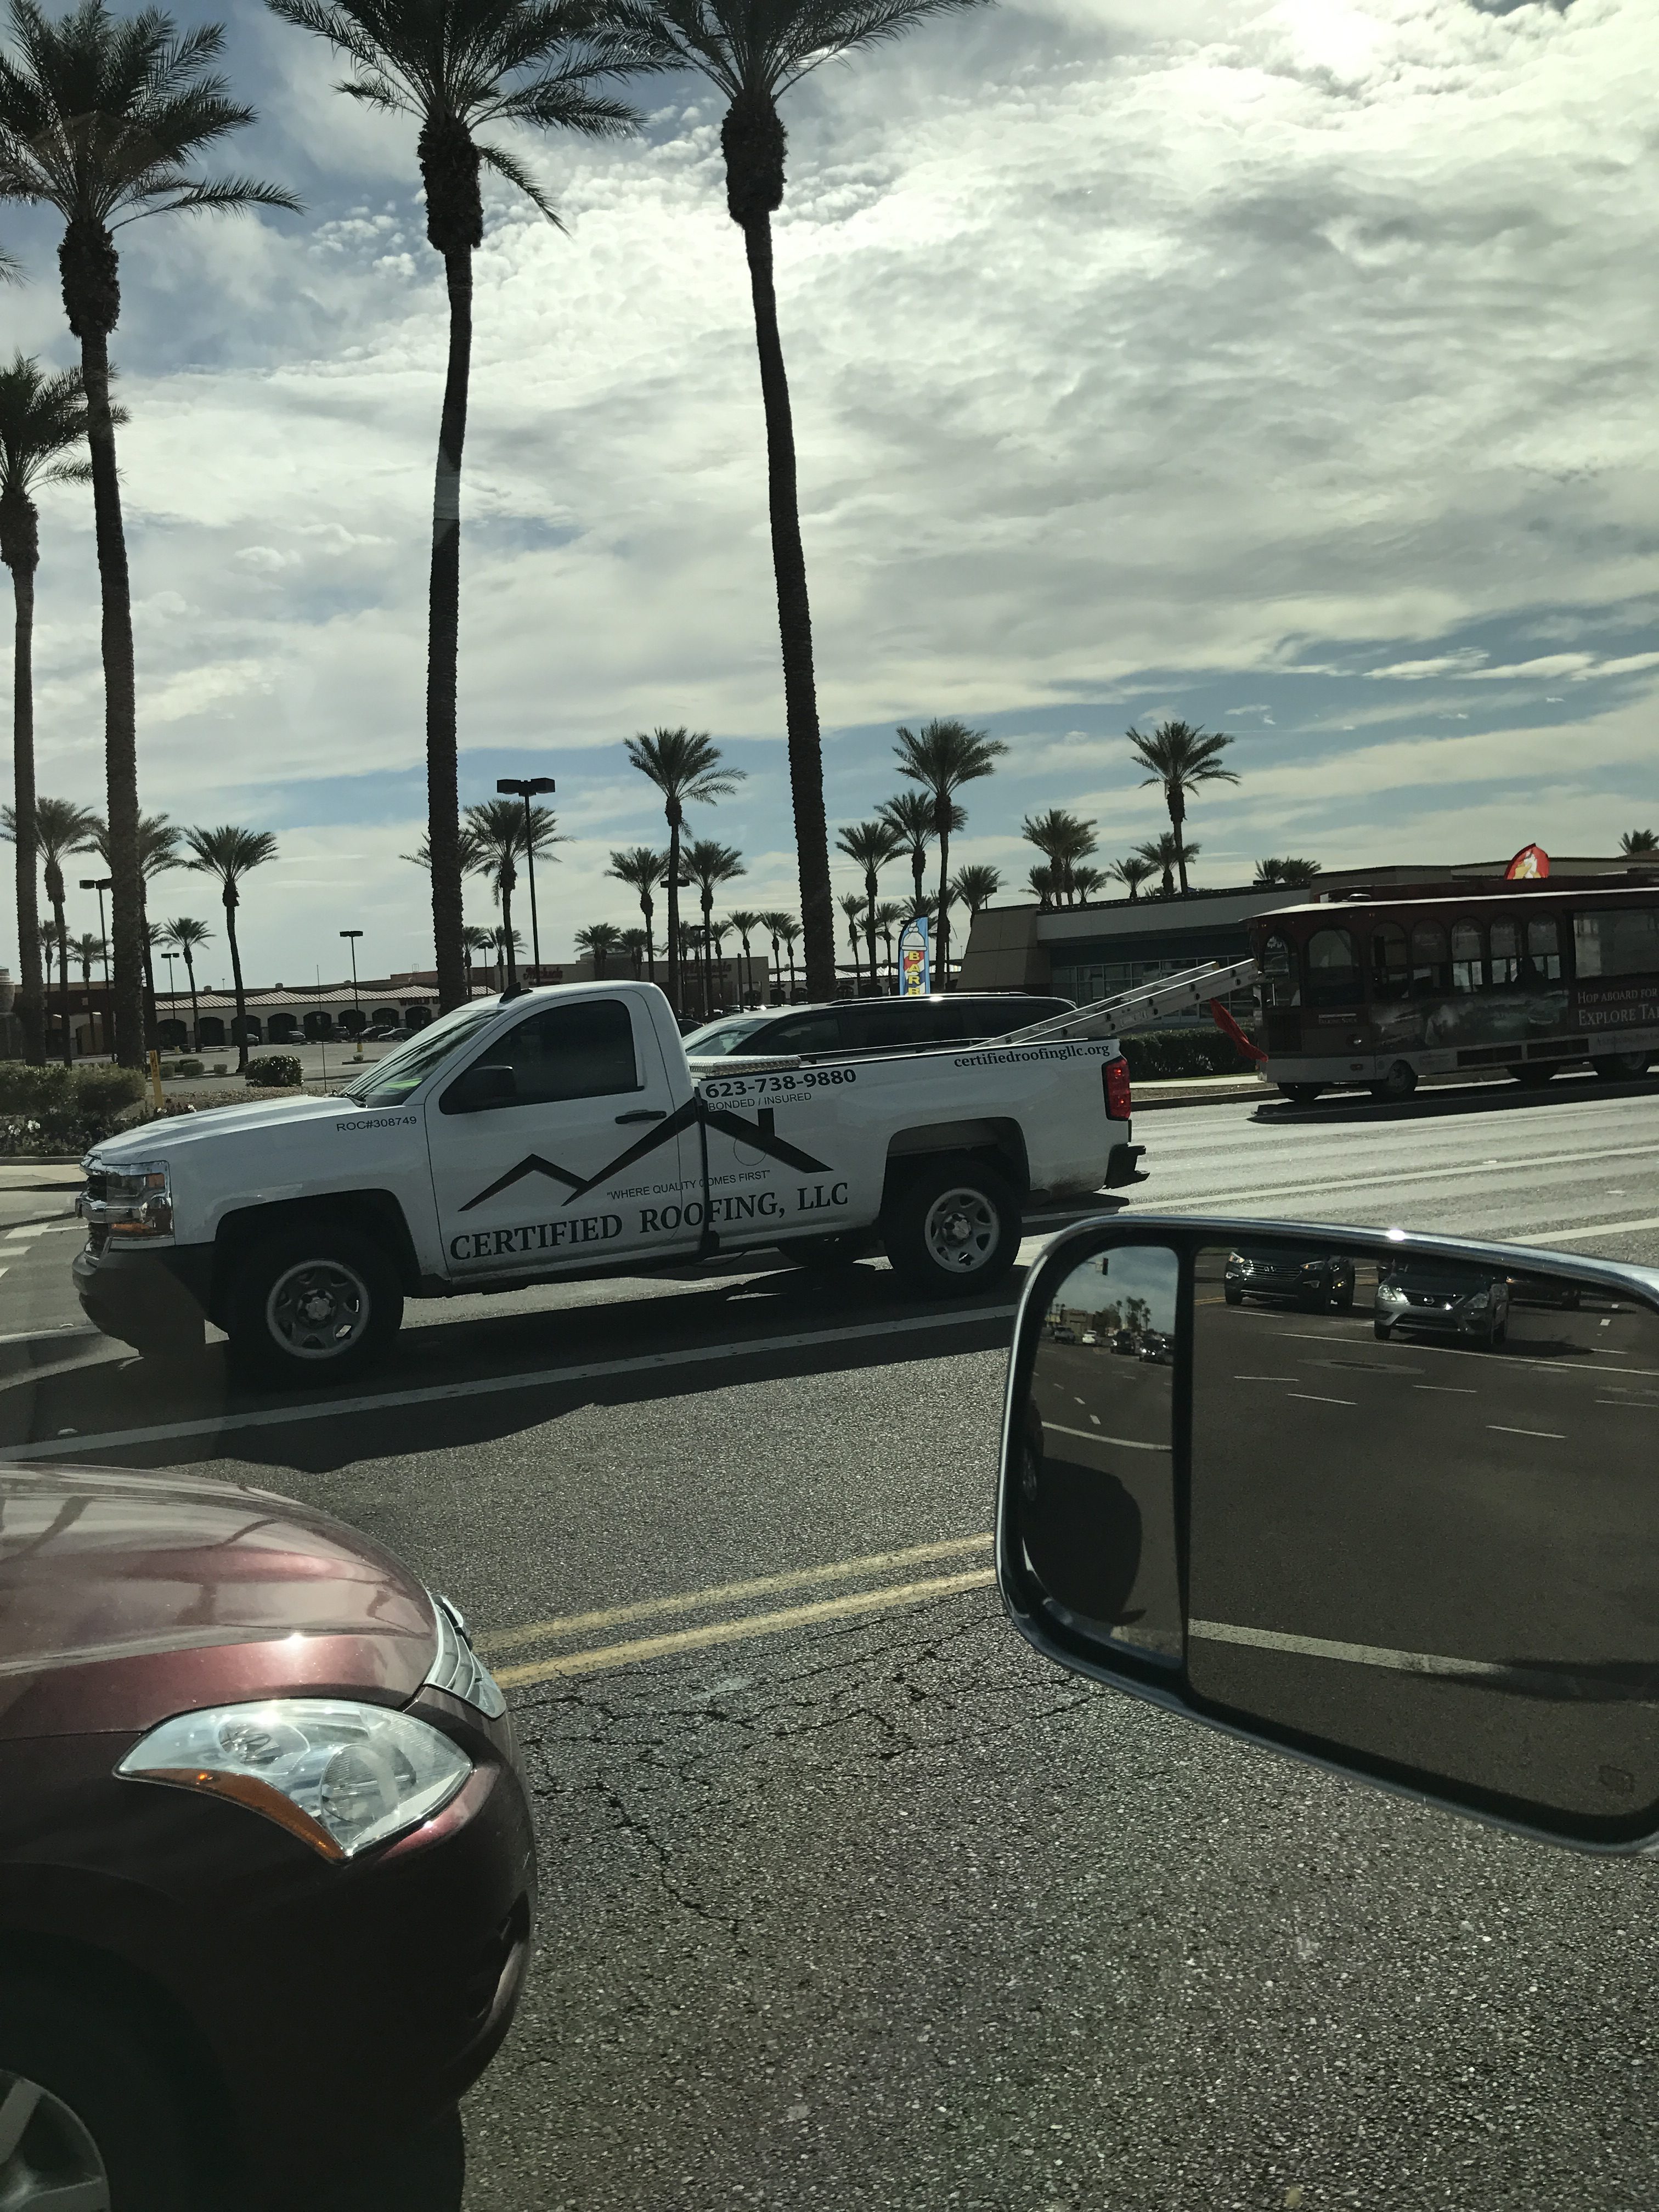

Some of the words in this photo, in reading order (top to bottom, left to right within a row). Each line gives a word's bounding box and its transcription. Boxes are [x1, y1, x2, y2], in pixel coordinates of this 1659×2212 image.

[1578, 991, 1599, 1004] HOP
[1601, 990, 1638, 1002] ABOARD
[1641, 988, 1658, 998] FOR
[1578, 1008, 1637, 1026] EXPLORE
[954, 1045, 1110, 1067] certifiedroofingllc.org
[706, 1069, 856, 1098] 623-738-9880
[709, 1098, 755, 1111] BONDED
[764, 1092, 812, 1105] INSURED
[336, 1116, 417, 1132] ROC#308749
[607, 1186, 650, 1200] "WHERE
[653, 1180, 696, 1194] QUALITY
[739, 1170, 770, 1182] FIRST"
[450, 1214, 623, 1260] CERTIFIED
[639, 1192, 785, 1233] ROOFING,
[797, 1182, 848, 1211] LLC
